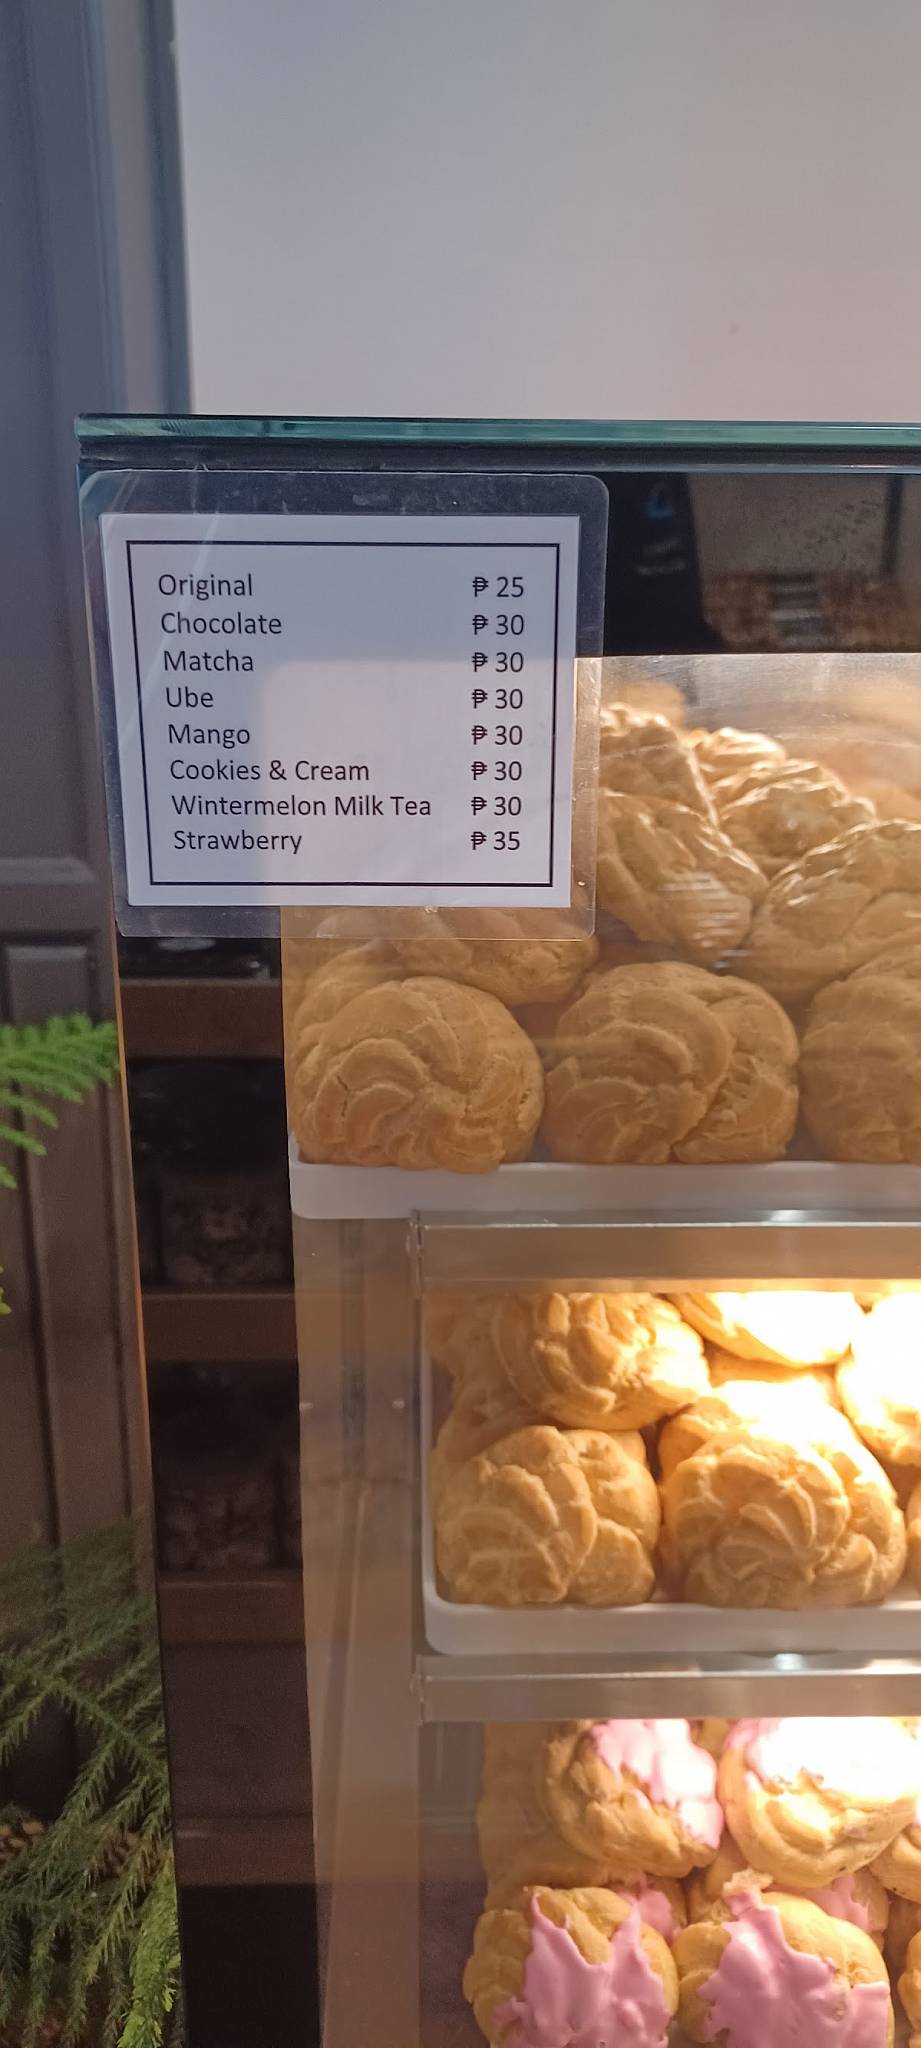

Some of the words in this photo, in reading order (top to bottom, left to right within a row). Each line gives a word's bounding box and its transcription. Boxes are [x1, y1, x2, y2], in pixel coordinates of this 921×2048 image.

[157, 572, 253, 602] Original
[471, 575, 490, 598] ₱
[495, 575, 525, 599] 25
[160, 610, 283, 635] Chocolate
[471, 614, 489, 636] ₱
[495, 613, 525, 636] 30
[163, 648, 255, 672] Matcha
[471, 651, 489, 673] ₱
[494, 651, 525, 674] 30
[165, 685, 214, 709] Ube
[470, 688, 489, 710] ₱
[493, 687, 524, 710] 30
[167, 723, 251, 750] Mango
[470, 724, 489, 746] ₱
[493, 724, 524, 746] 30
[169, 757, 262, 783] Cookies
[267, 759, 288, 782] &
[294, 760, 370, 782] Cream
[470, 760, 489, 782] ₱
[493, 760, 523, 782] 30
[170, 793, 327, 817] Wintermelon
[334, 794, 385, 817] Milk
[389, 795, 432, 816] Tea
[470, 795, 488, 817] ₱
[492, 795, 523, 817] 30
[173, 828, 303, 856] Strawberry
[469, 830, 489, 851] ₱
[492, 830, 521, 851] 35
